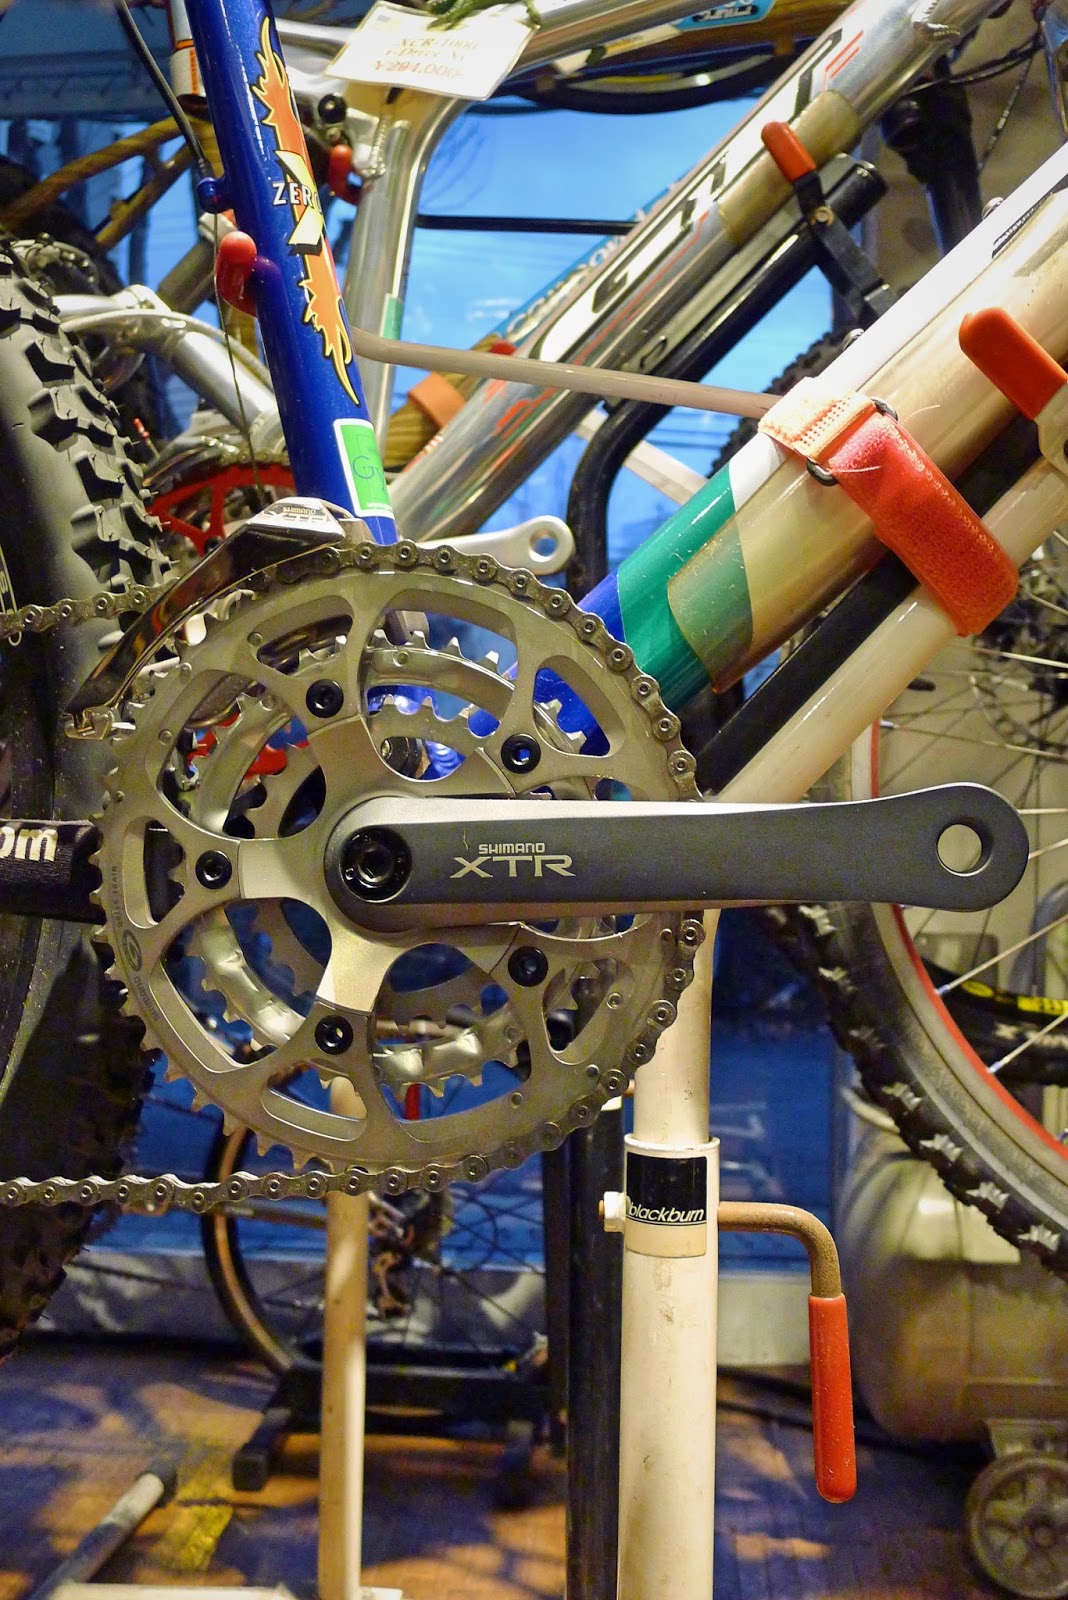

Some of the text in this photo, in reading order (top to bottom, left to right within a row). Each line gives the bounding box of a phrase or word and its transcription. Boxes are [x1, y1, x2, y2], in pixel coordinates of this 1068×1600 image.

[478, 842, 546, 855] SHIMANO
[449, 854, 577, 879] XTR
[628, 1201, 705, 1223] blackburn
